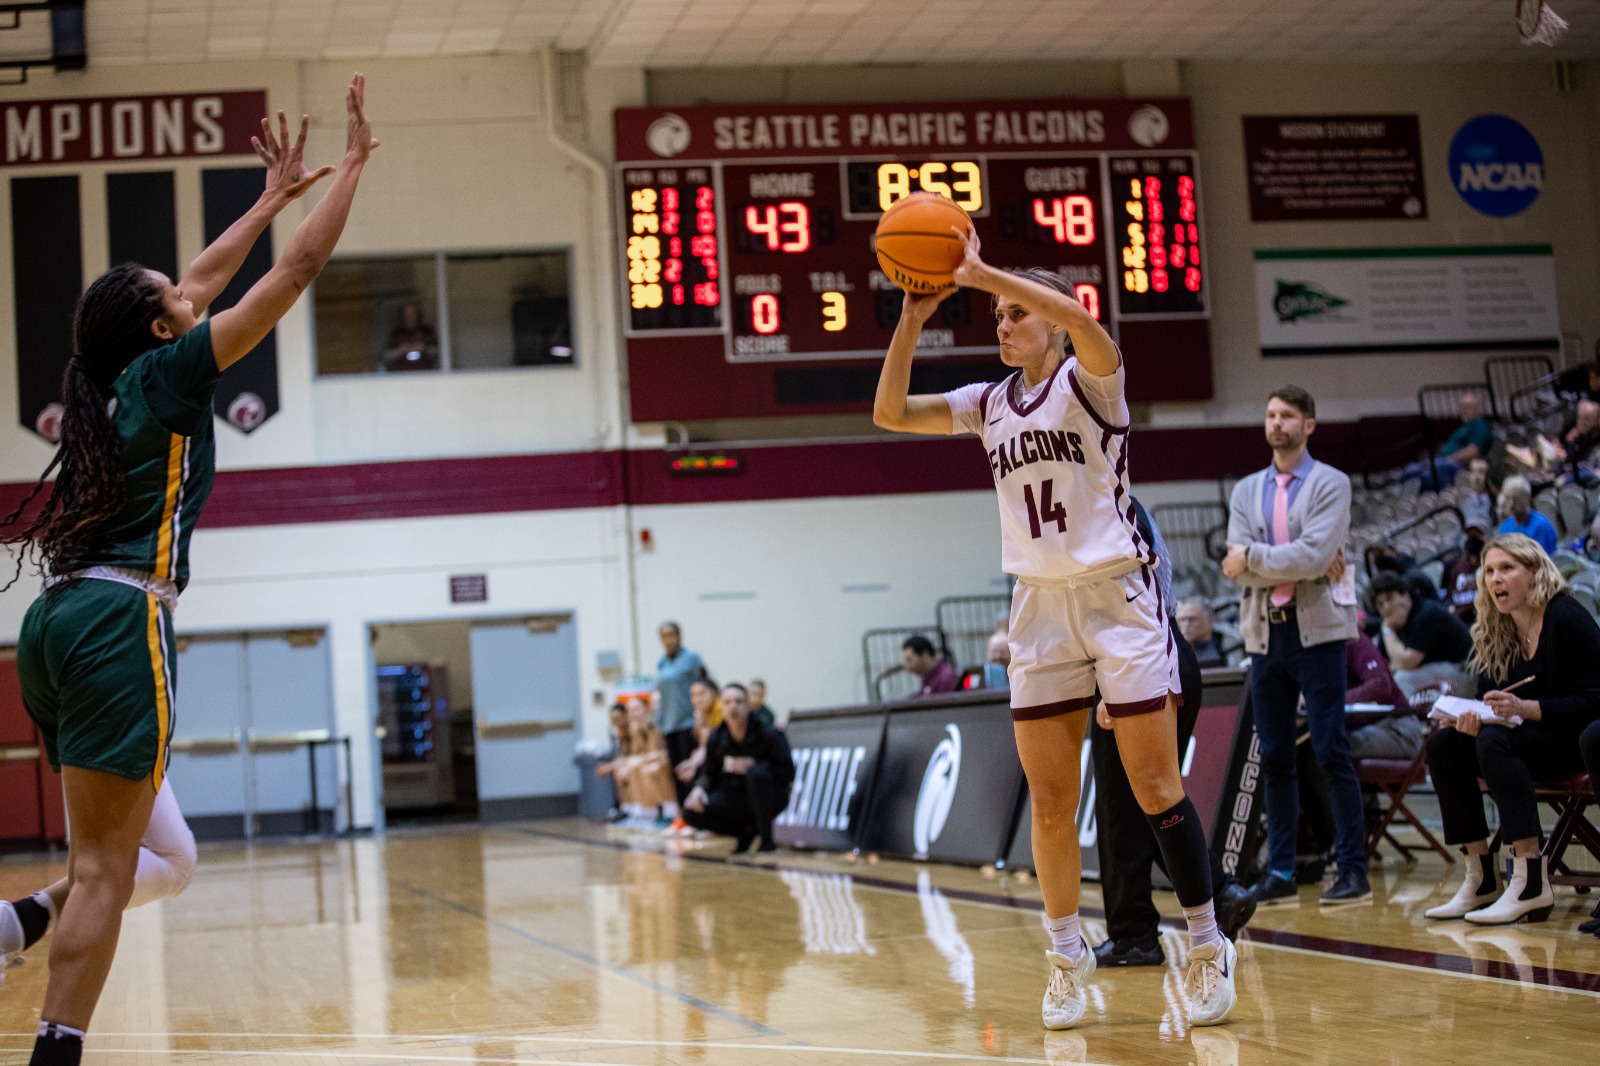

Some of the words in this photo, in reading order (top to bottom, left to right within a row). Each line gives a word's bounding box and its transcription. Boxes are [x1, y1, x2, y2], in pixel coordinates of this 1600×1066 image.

[4, 97, 226, 163] MPIONS
[714, 113, 840, 151] SEATTLE
[850, 111, 967, 147] PACIFIC
[974, 108, 1105, 145] FALCONS
[749, 172, 815, 197] HOME
[1024, 165, 1087, 192] GUEST
[1178, 175, 1194, 200] 2
[1458, 161, 1544, 193] NCAA
[696, 186, 714, 211] 2
[1179, 199, 1196, 222] 2
[662, 211, 680, 235] 2
[745, 202, 811, 253] 43
[1033, 196, 1095, 246] 48
[664, 258, 683, 283] 2
[751, 294, 780, 333] 0
[821, 291, 847, 331] 3
[989, 430, 1085, 484] FALCONS
[1023, 479, 1067, 539] 14
[1222, 724, 1261, 876] LCONS
